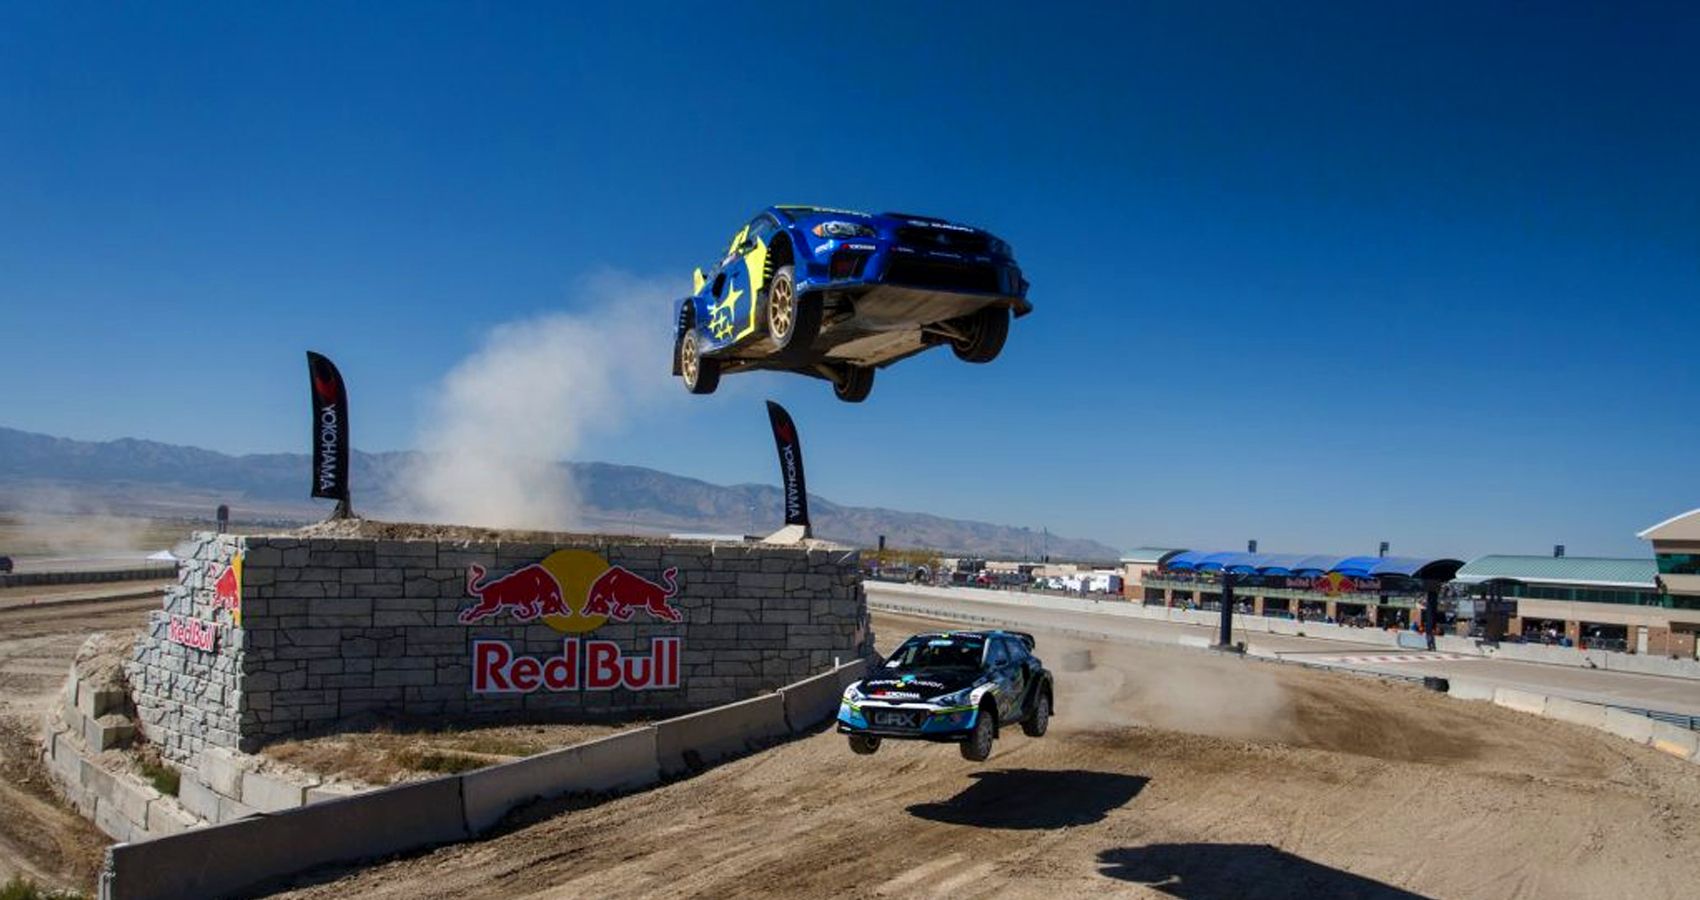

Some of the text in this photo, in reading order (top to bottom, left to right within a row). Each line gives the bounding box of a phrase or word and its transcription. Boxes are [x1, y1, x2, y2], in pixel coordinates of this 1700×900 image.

[320, 403, 338, 490] YOKOHAMA
[782, 444, 800, 519] YOKOHAMA
[169, 616, 193, 644] Red
[475, 638, 679, 691] Red Bull
